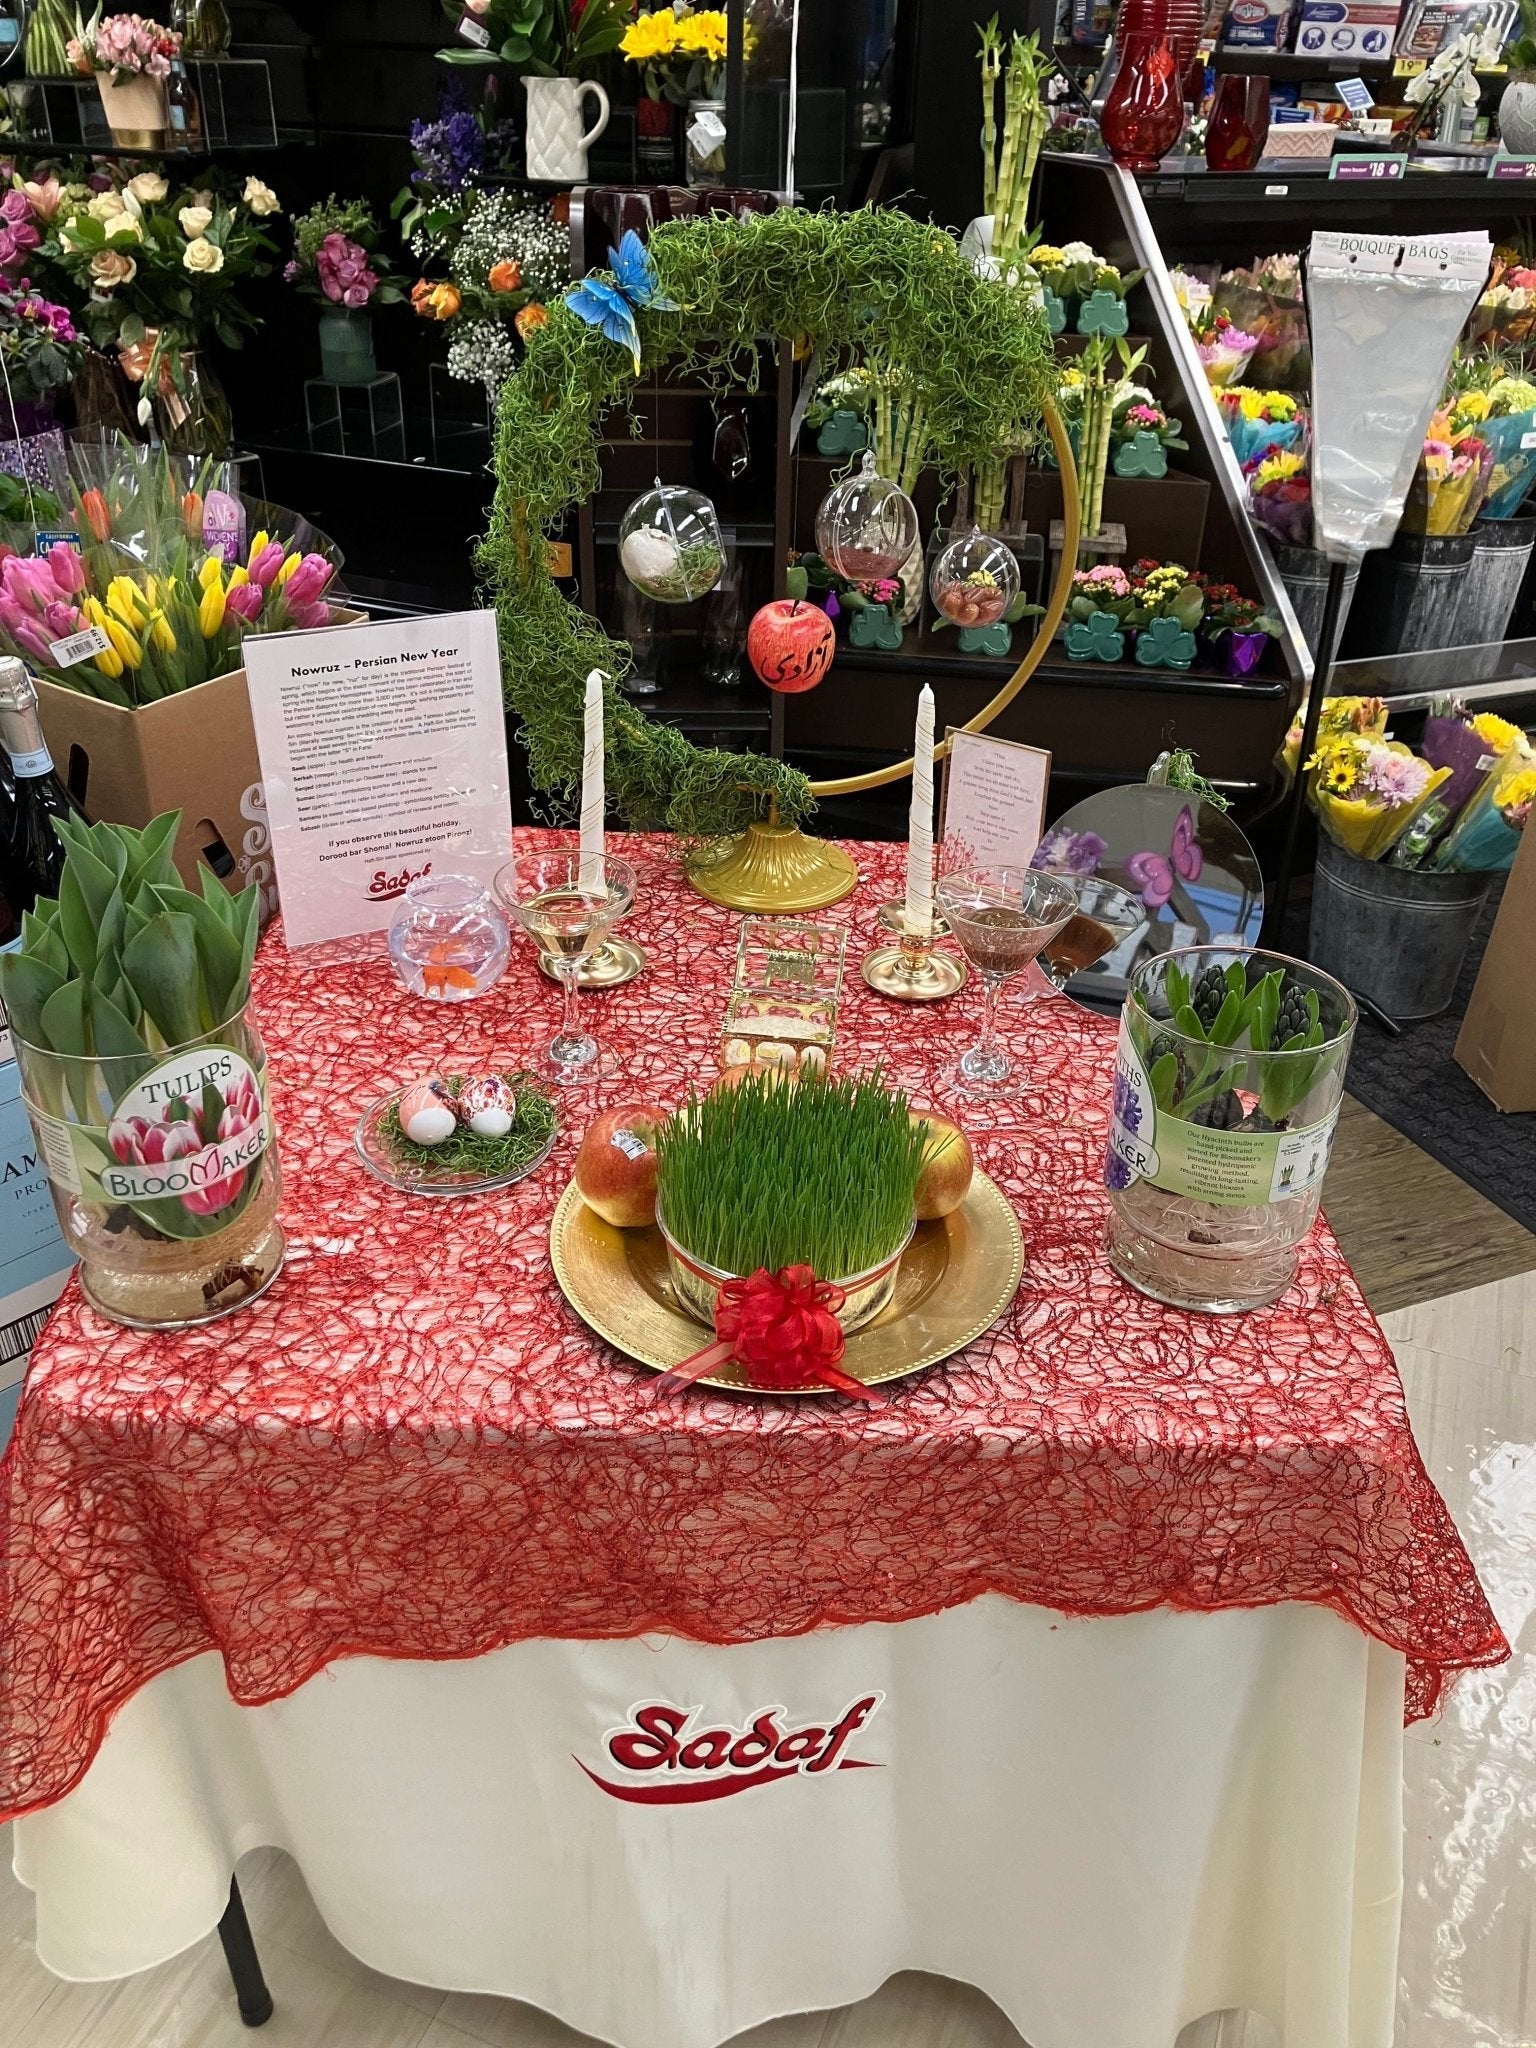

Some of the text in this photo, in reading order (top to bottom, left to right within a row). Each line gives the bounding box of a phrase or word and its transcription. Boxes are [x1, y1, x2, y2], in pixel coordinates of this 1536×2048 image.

[1369, 162, 1385, 177] $18
[1408, 244, 1449, 260] BAGS
[291, 664, 341, 678] Nowruz
[354, 656, 398, 669] Persian
[400, 652, 429, 663] New
[431, 648, 459, 658] Year
[335, 839, 350, 848] you
[351, 833, 382, 844] observe
[383, 830, 398, 838] this
[398, 824, 431, 835] beautiful
[432, 820, 461, 829] holiday,
[319, 851, 348, 862] Dorood
[349, 849, 362, 857] bar
[363, 843, 392, 854] Shoma!
[395, 839, 424, 848] Nowruz
[425, 835, 446, 843] etoon
[142, 1055, 232, 1104] TULIPS
[1187, 1130, 1200, 1138] Our
[1201, 1134, 1233, 1144] Hyacinth
[1187, 1147, 1208, 1156] sorted
[1209, 1151, 1219, 1159] for
[1196, 1140, 1238, 1153] hand-picked
[110, 1129, 267, 1197] BLOOMAKER
[1187, 1154, 1257, 1169] patented hydroponic
[1191, 1163, 1219, 1175] growing
[1180, 1167, 1209, 1180] resulting
[1187, 1184, 1202, 1193] with
[1203, 1189, 1225, 1198] strong
[1194, 1179, 1244, 1191] vibrant blooms
[607, 1694, 879, 1774] Sadaf
